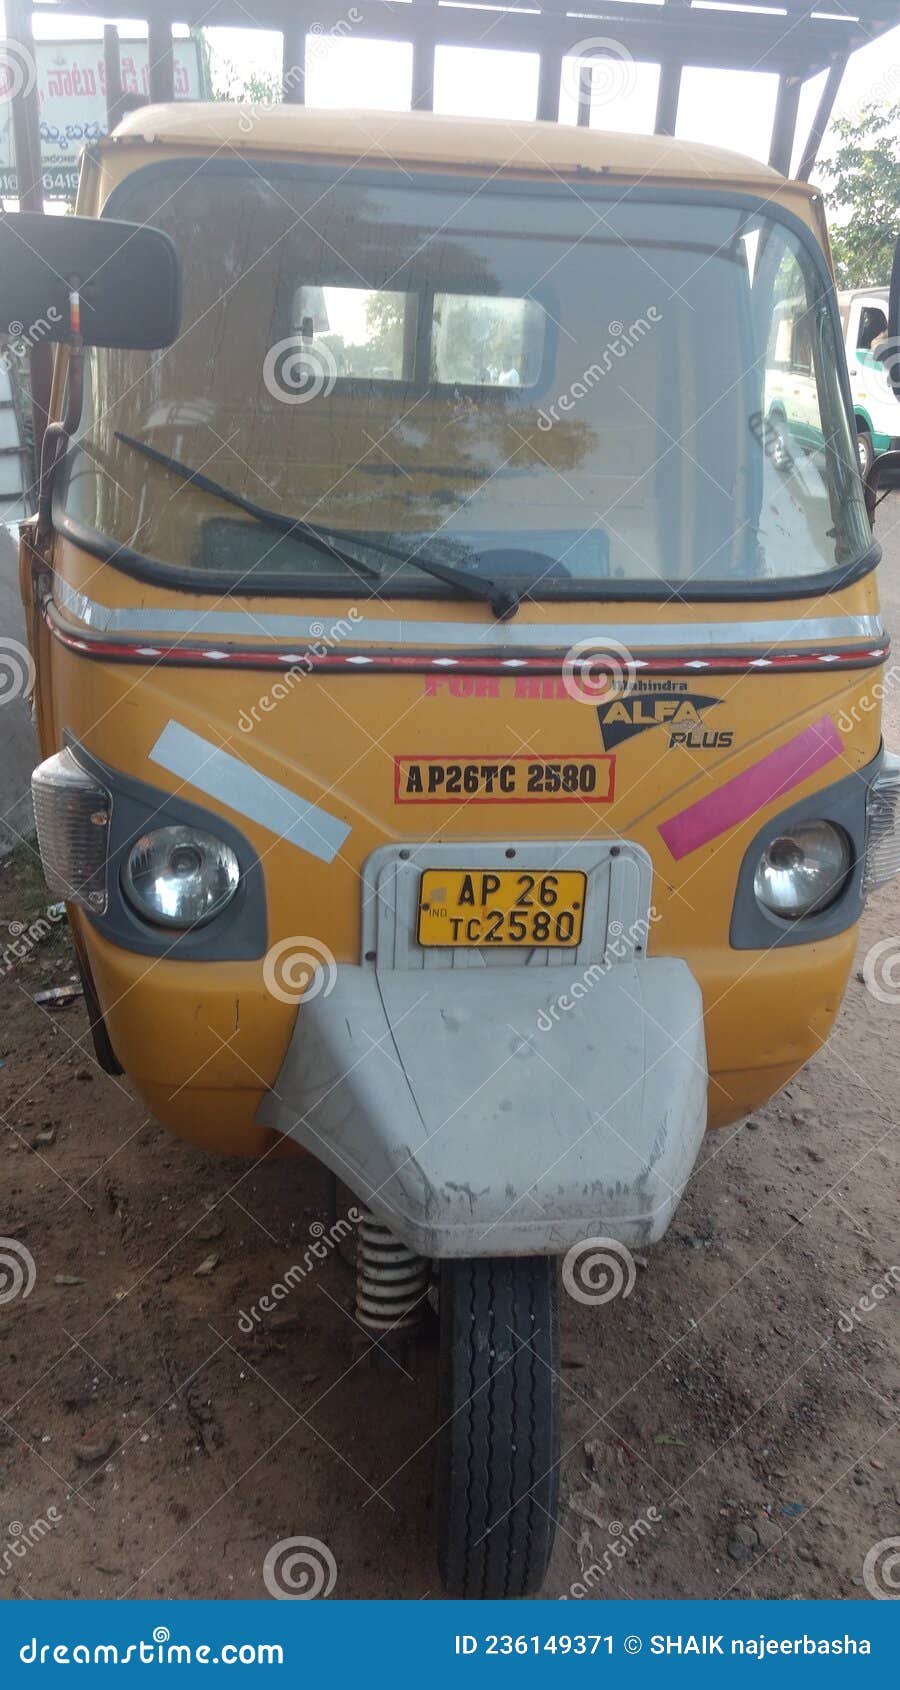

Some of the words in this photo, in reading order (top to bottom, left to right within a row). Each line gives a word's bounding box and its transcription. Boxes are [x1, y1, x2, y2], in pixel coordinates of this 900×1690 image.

[602, 700, 702, 724] ALFA
[669, 731, 733, 748] PLUS
[527, 764, 596, 793] 2580
[457, 874, 501, 906] AP
[516, 875, 560, 906] 26
